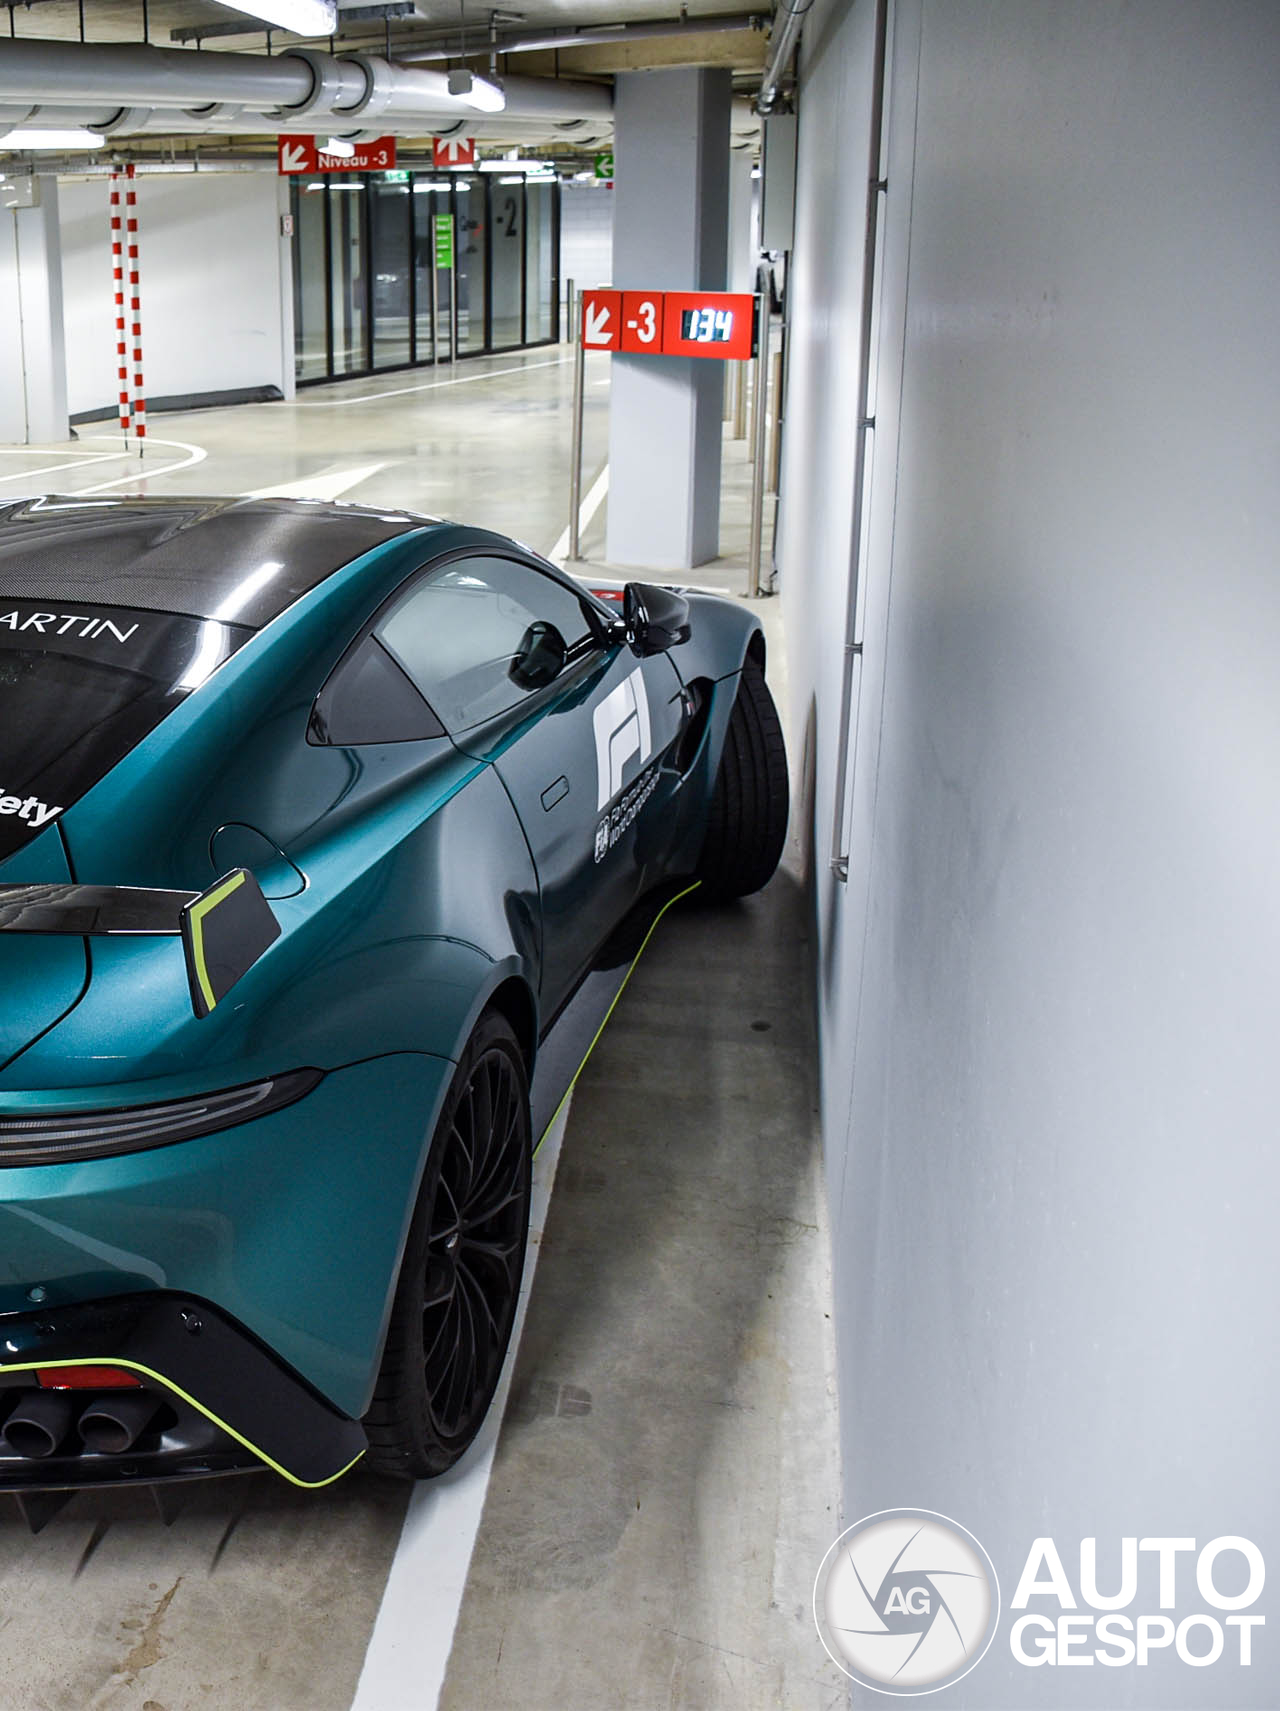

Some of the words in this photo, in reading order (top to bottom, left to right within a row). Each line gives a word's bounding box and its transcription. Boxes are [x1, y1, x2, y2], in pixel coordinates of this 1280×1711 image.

[318, 154, 368, 168] Niveau
[373, 151, 388, 166] -3
[496, 197, 517, 237] -2
[627, 301, 656, 343] -3
[688, 308, 734, 343] 134
